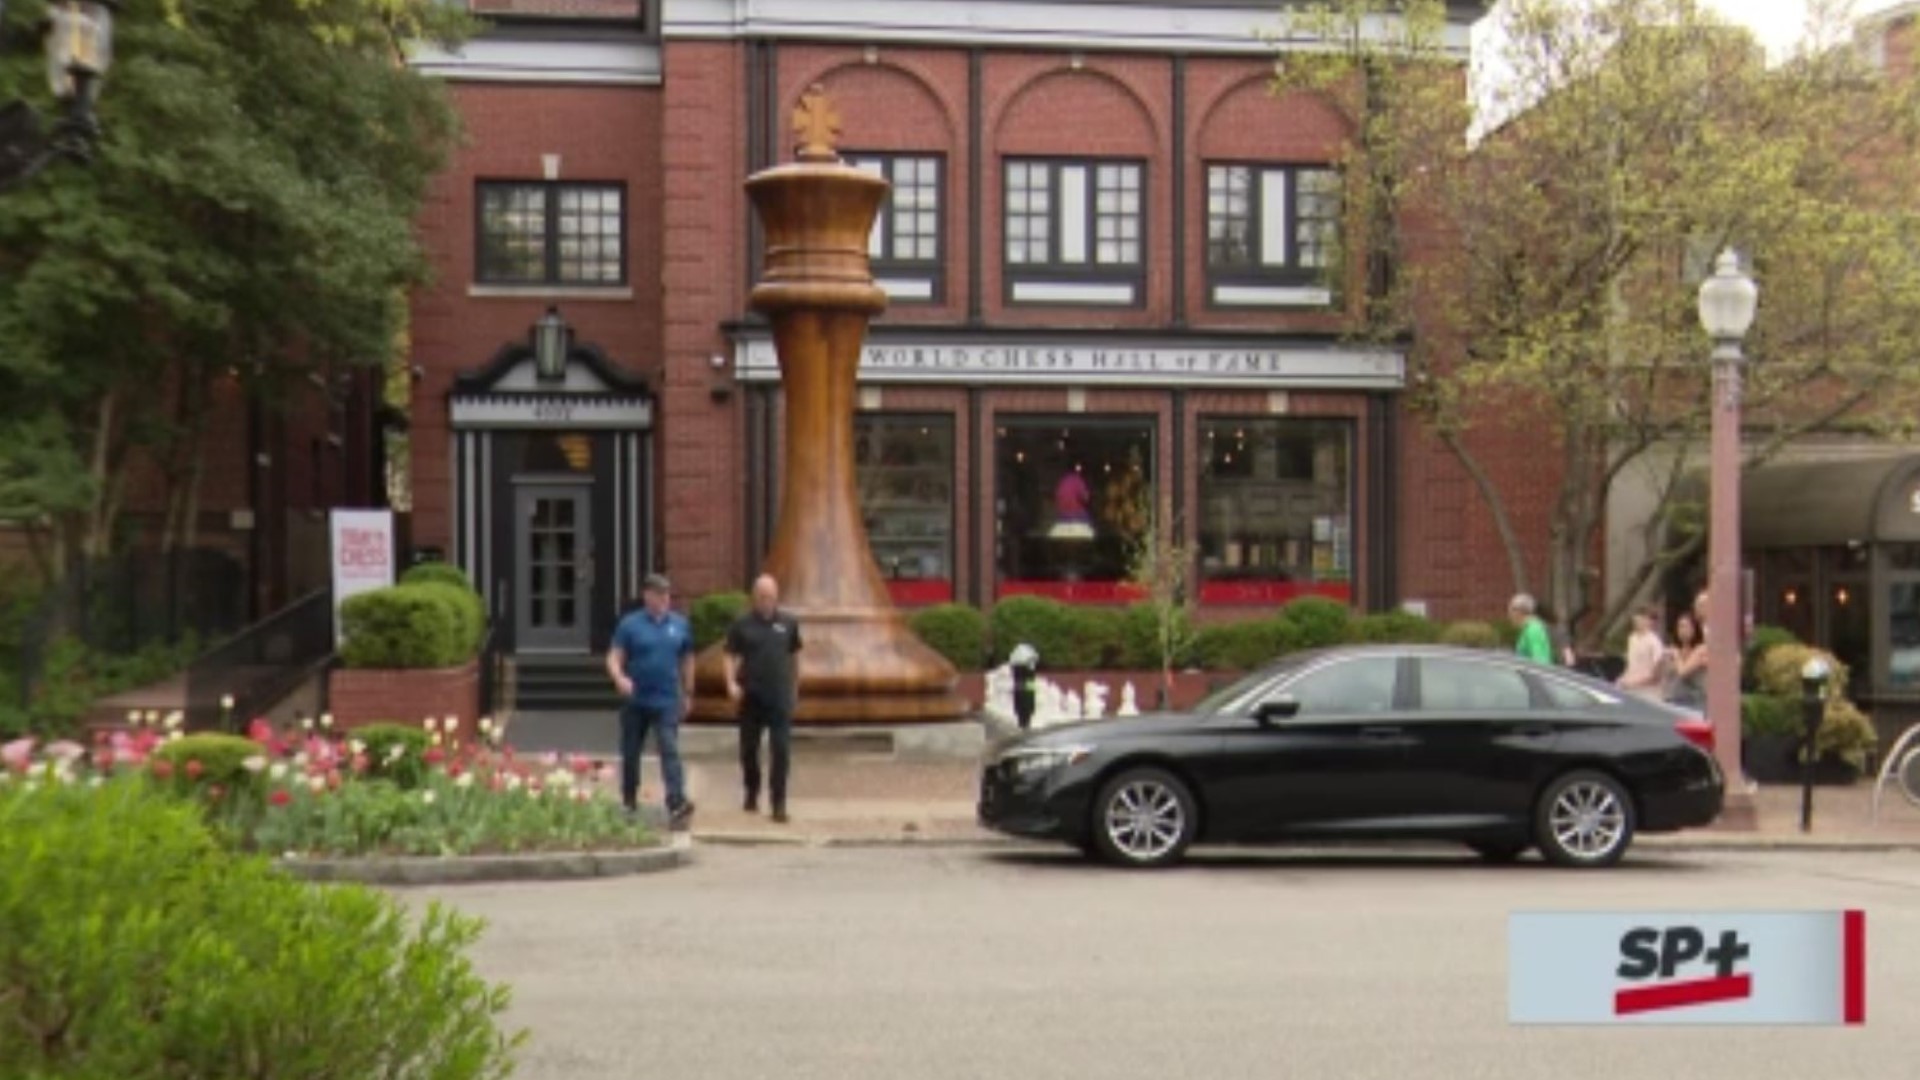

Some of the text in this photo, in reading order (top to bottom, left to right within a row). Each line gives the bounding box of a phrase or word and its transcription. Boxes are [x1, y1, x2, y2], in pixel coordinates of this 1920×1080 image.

[868, 349, 969, 367] WORLD
[980, 349, 1073, 368] CHESS
[1092, 351, 1165, 369] HALL
[1208, 351, 1281, 371] FAME
